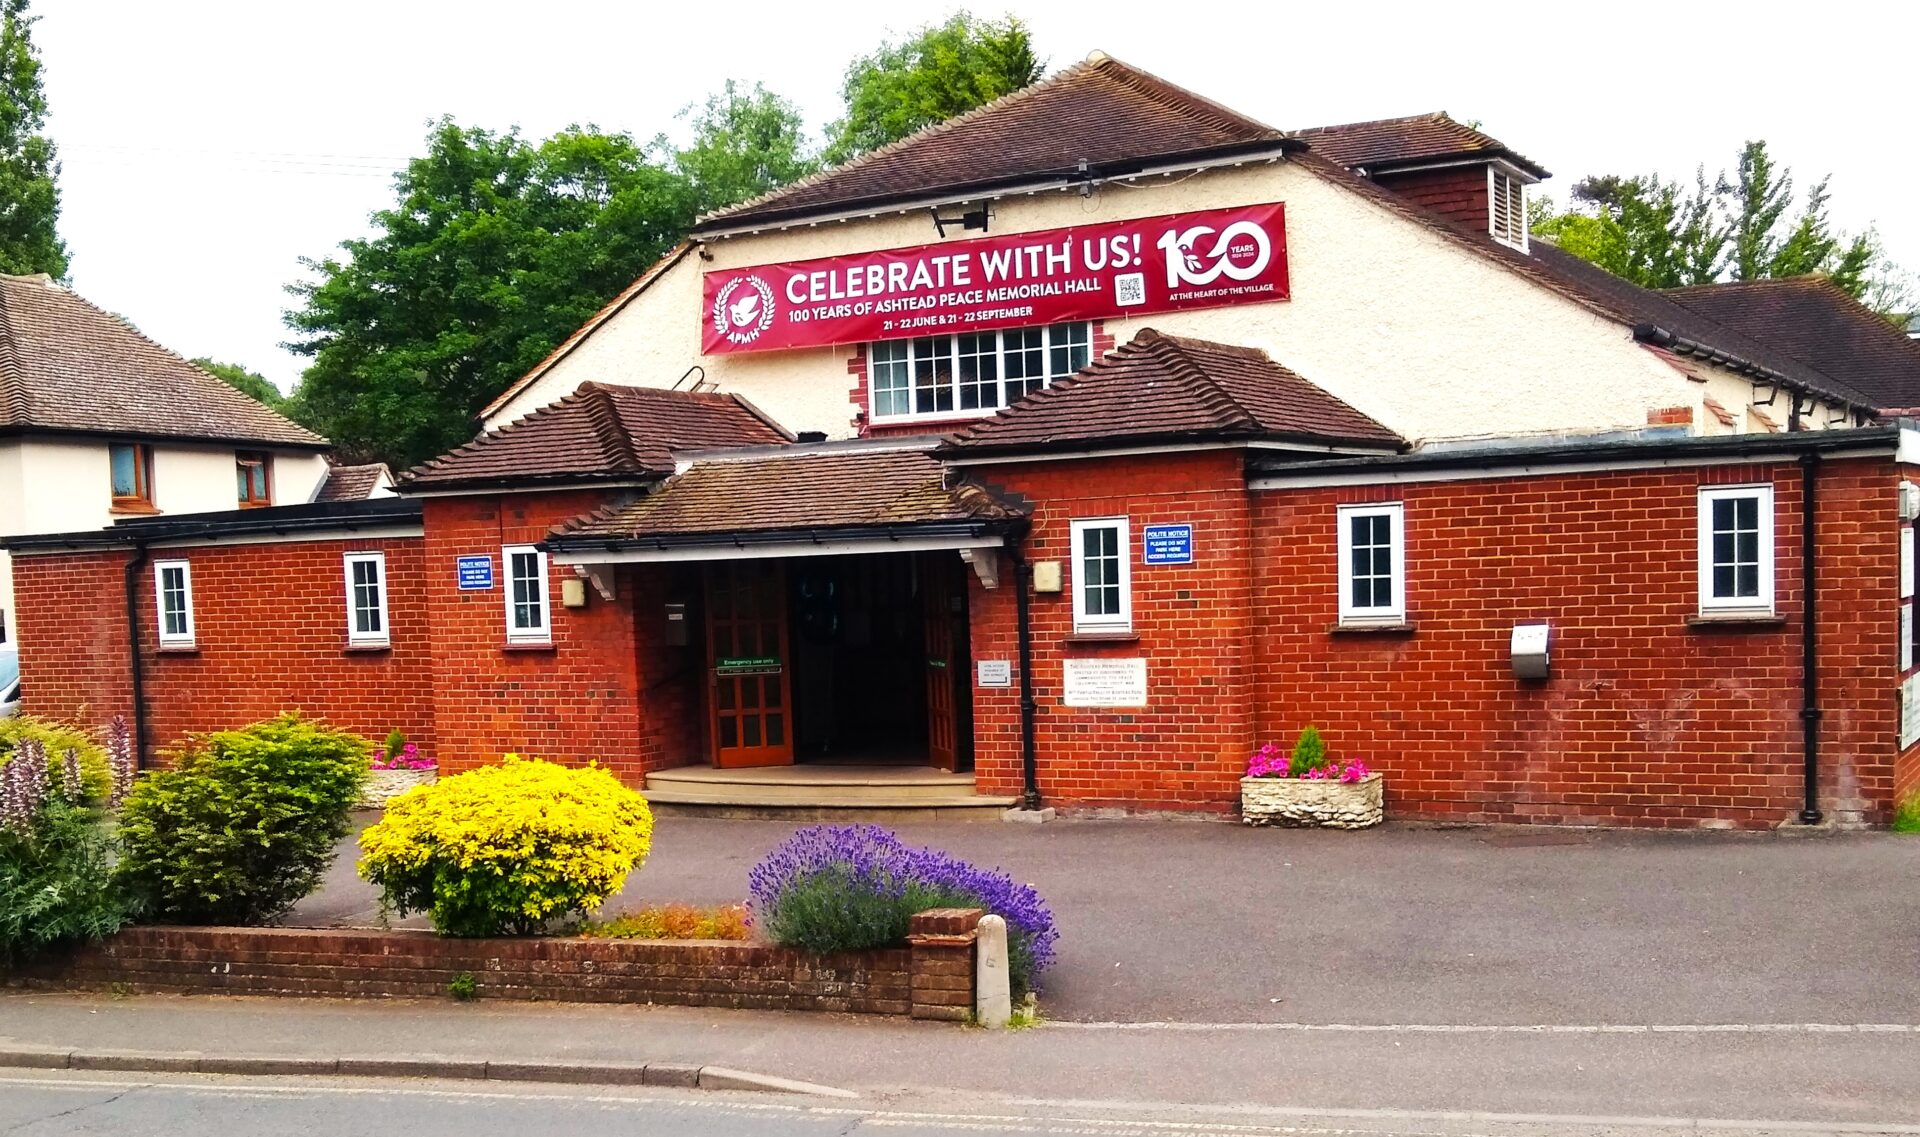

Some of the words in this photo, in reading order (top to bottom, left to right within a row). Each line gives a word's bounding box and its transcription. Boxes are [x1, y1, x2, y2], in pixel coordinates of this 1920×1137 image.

[1230, 244, 1254, 253] YEARS
[786, 254, 971, 304] CELEBRATE
[980, 243, 1071, 283] WITH
[1084, 233, 1142, 271] US!
[789, 309, 810, 323] 100
[811, 304, 851, 320] YEARS
[854, 302, 873, 316] OF
[874, 295, 936, 314] ASHTEAD
[939, 290, 983, 307] PEACE
[986, 281, 1062, 303] MEMORIAL
[1065, 277, 1102, 294] HALL
[1169, 293, 1179, 301] AT
[1179, 292, 1193, 300] THE
[1193, 289, 1217, 299] HEART
[1217, 288, 1228, 296] OF
[1228, 287, 1243, 295] THE
[1243, 283, 1274, 293] VILLAGE
[883, 321, 893, 330] 21
[900, 319, 911, 329] 22
[911, 316, 937, 328] JUNE
[939, 315, 946, 325] &
[947, 314, 957, 324] 21
[964, 312, 975, 322] 22
[976, 306, 1033, 321] SEPTEMBER
[726, 329, 760, 345] APMH
